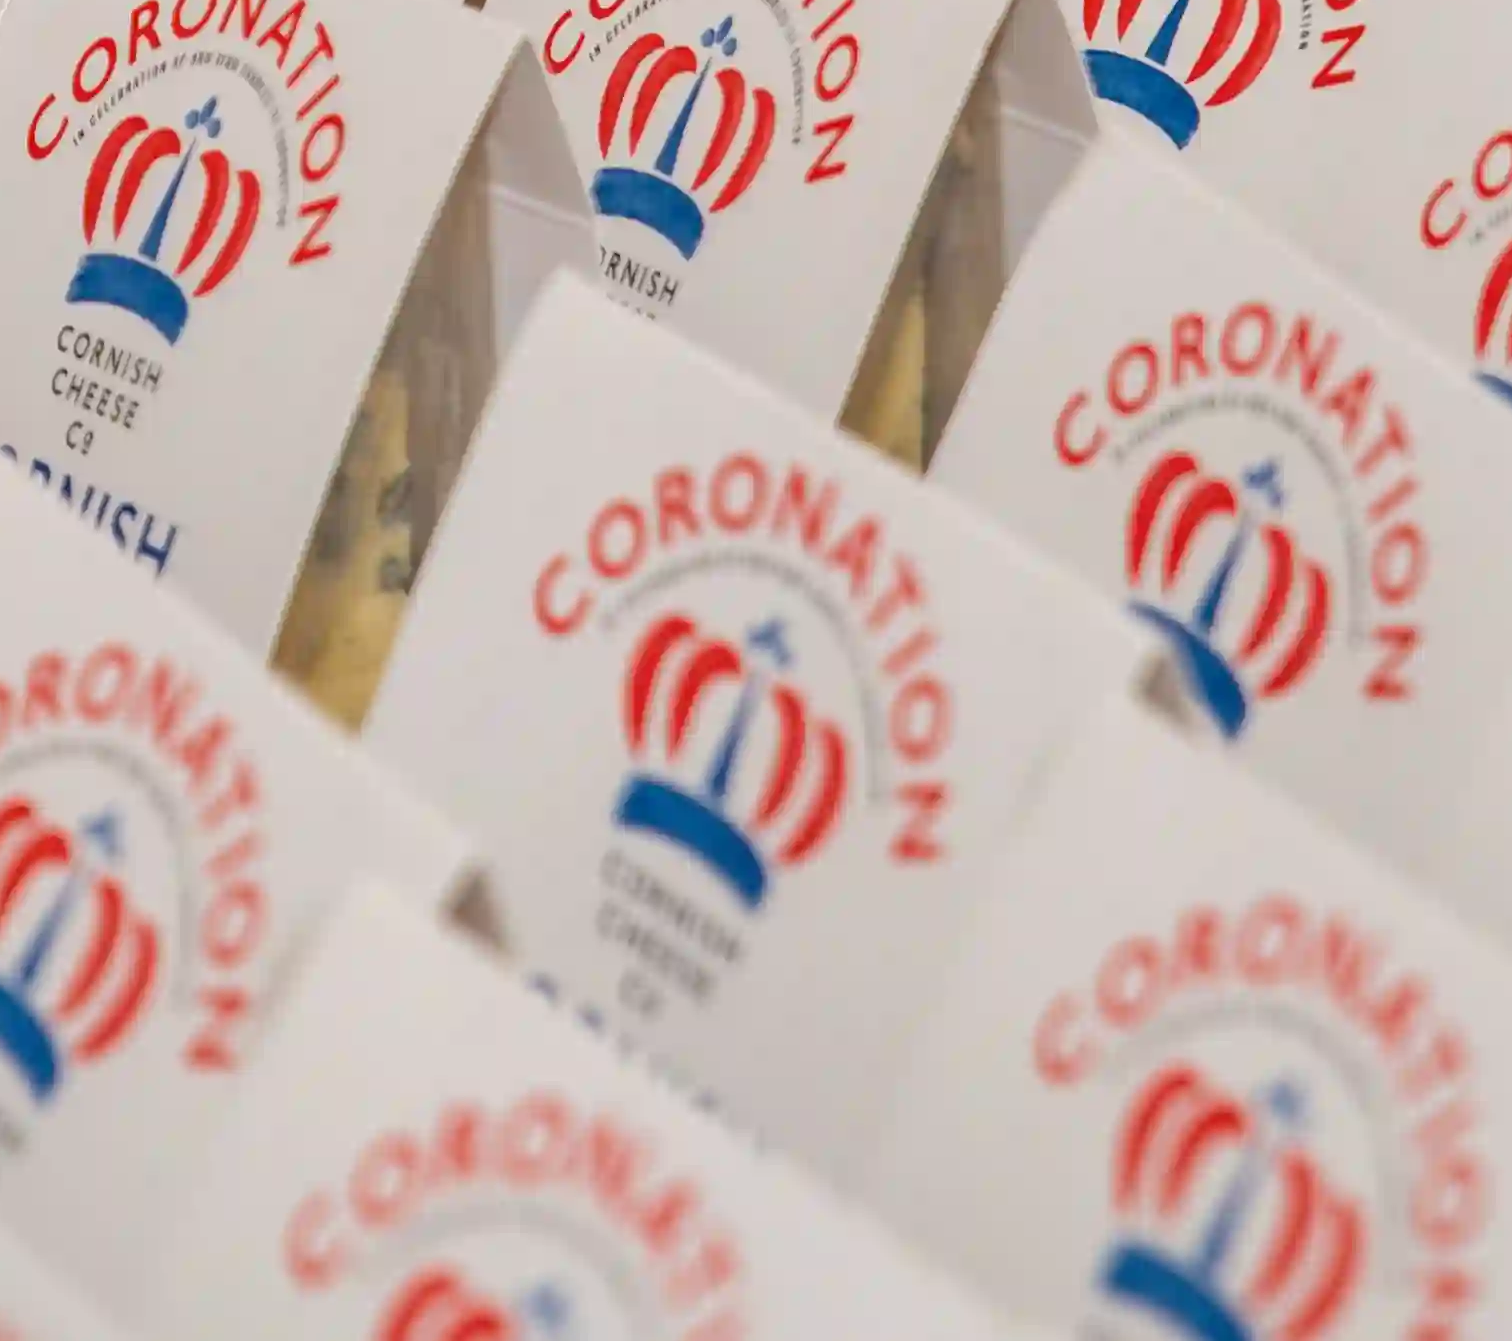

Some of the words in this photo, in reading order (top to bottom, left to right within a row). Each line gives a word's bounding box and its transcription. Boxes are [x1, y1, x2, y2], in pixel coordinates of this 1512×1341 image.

[588, 43, 601, 62] IN
[89, 60, 168, 127] CELEBRATION
[56, 324, 164, 394] CORNISH
[51, 367, 140, 430] CHEESE
[1052, 302, 1428, 703] CORONATION
[533, 450, 956, 865] CORONATION
